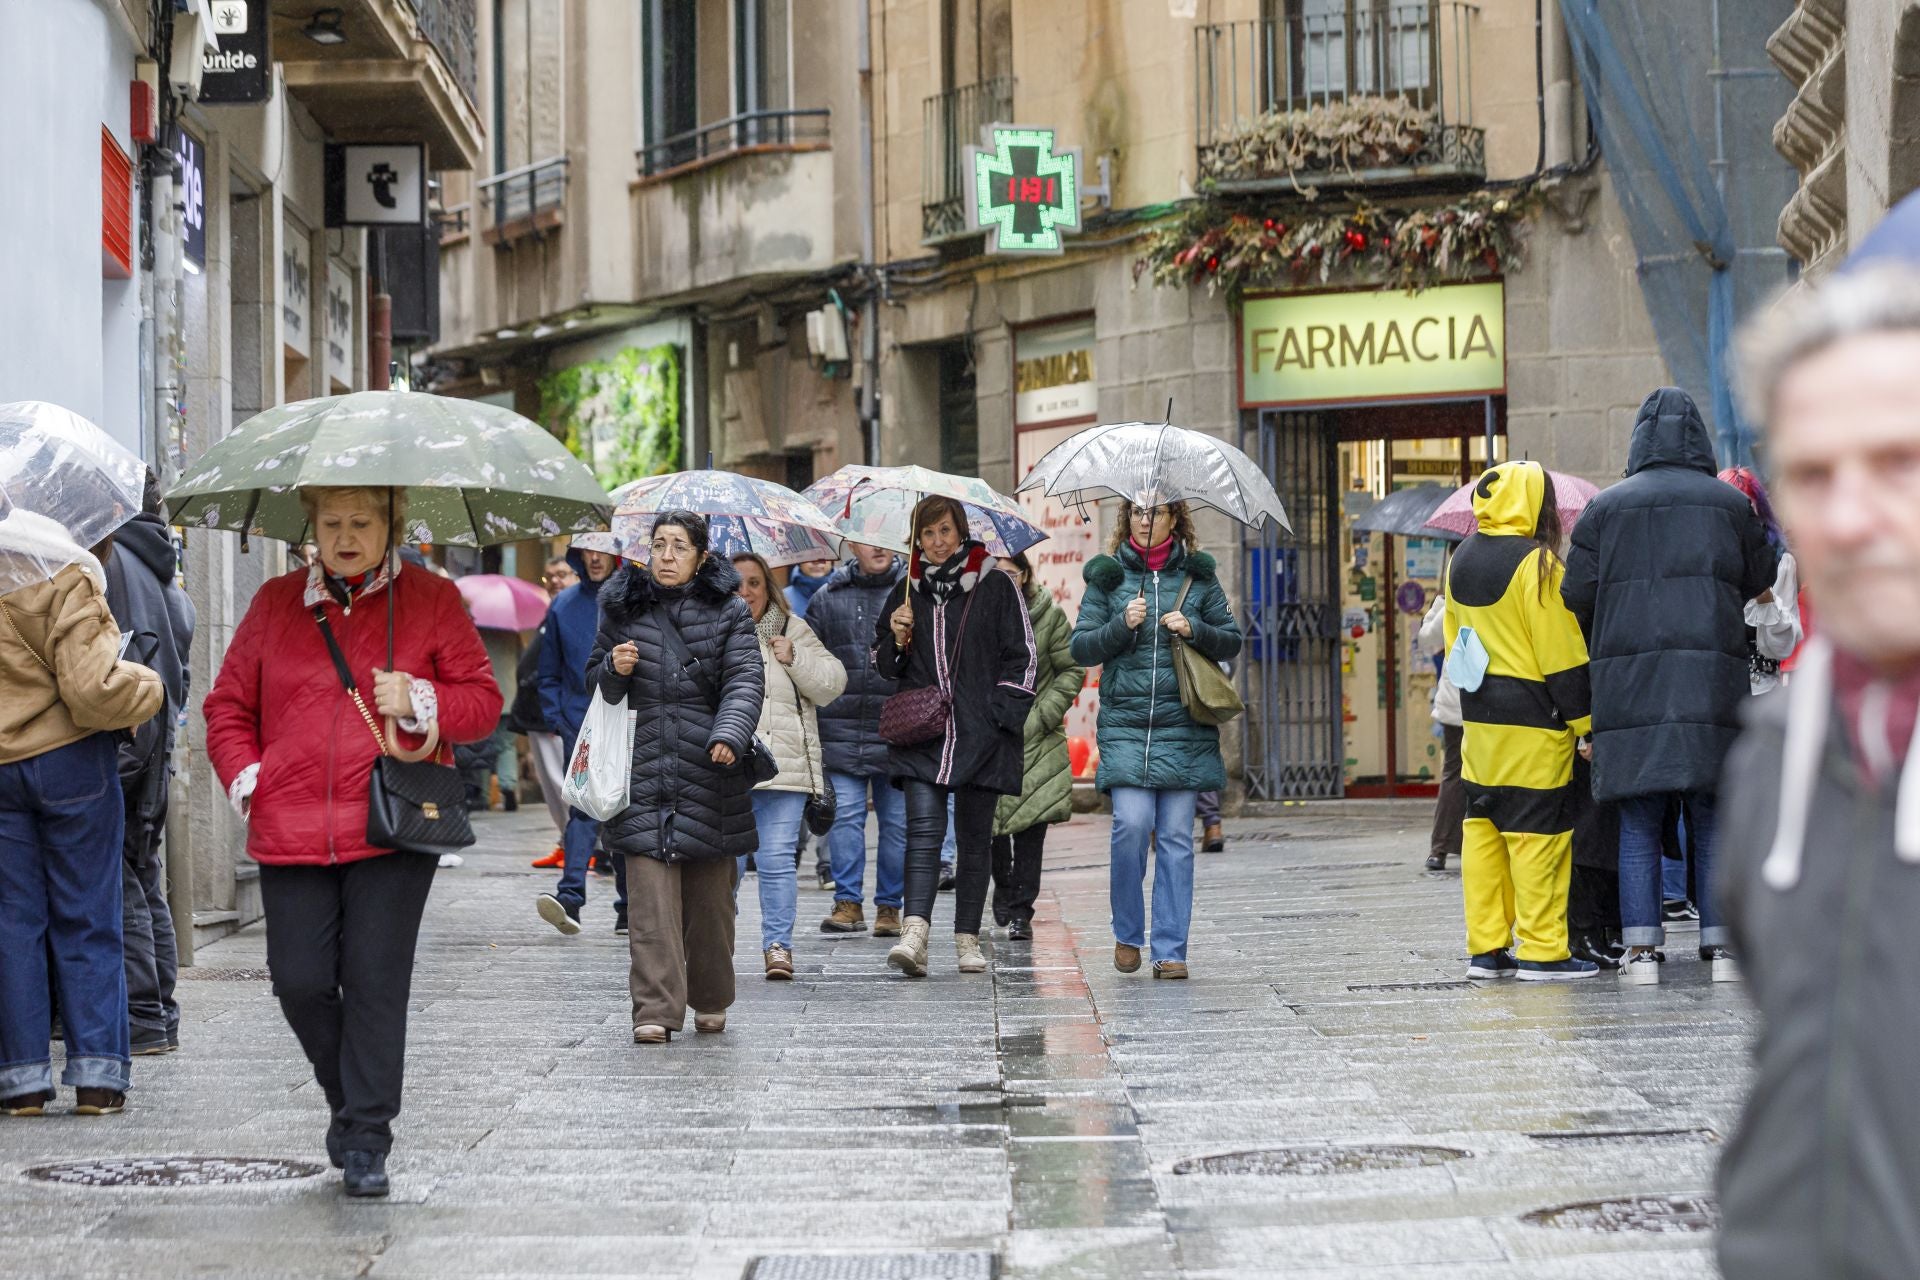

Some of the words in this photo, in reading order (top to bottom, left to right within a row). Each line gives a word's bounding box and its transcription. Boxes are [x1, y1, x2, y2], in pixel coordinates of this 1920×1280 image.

[203, 50, 257, 69] unide
[1251, 314, 1496, 375] FARMACIA
[1037, 550, 1083, 574] primera
